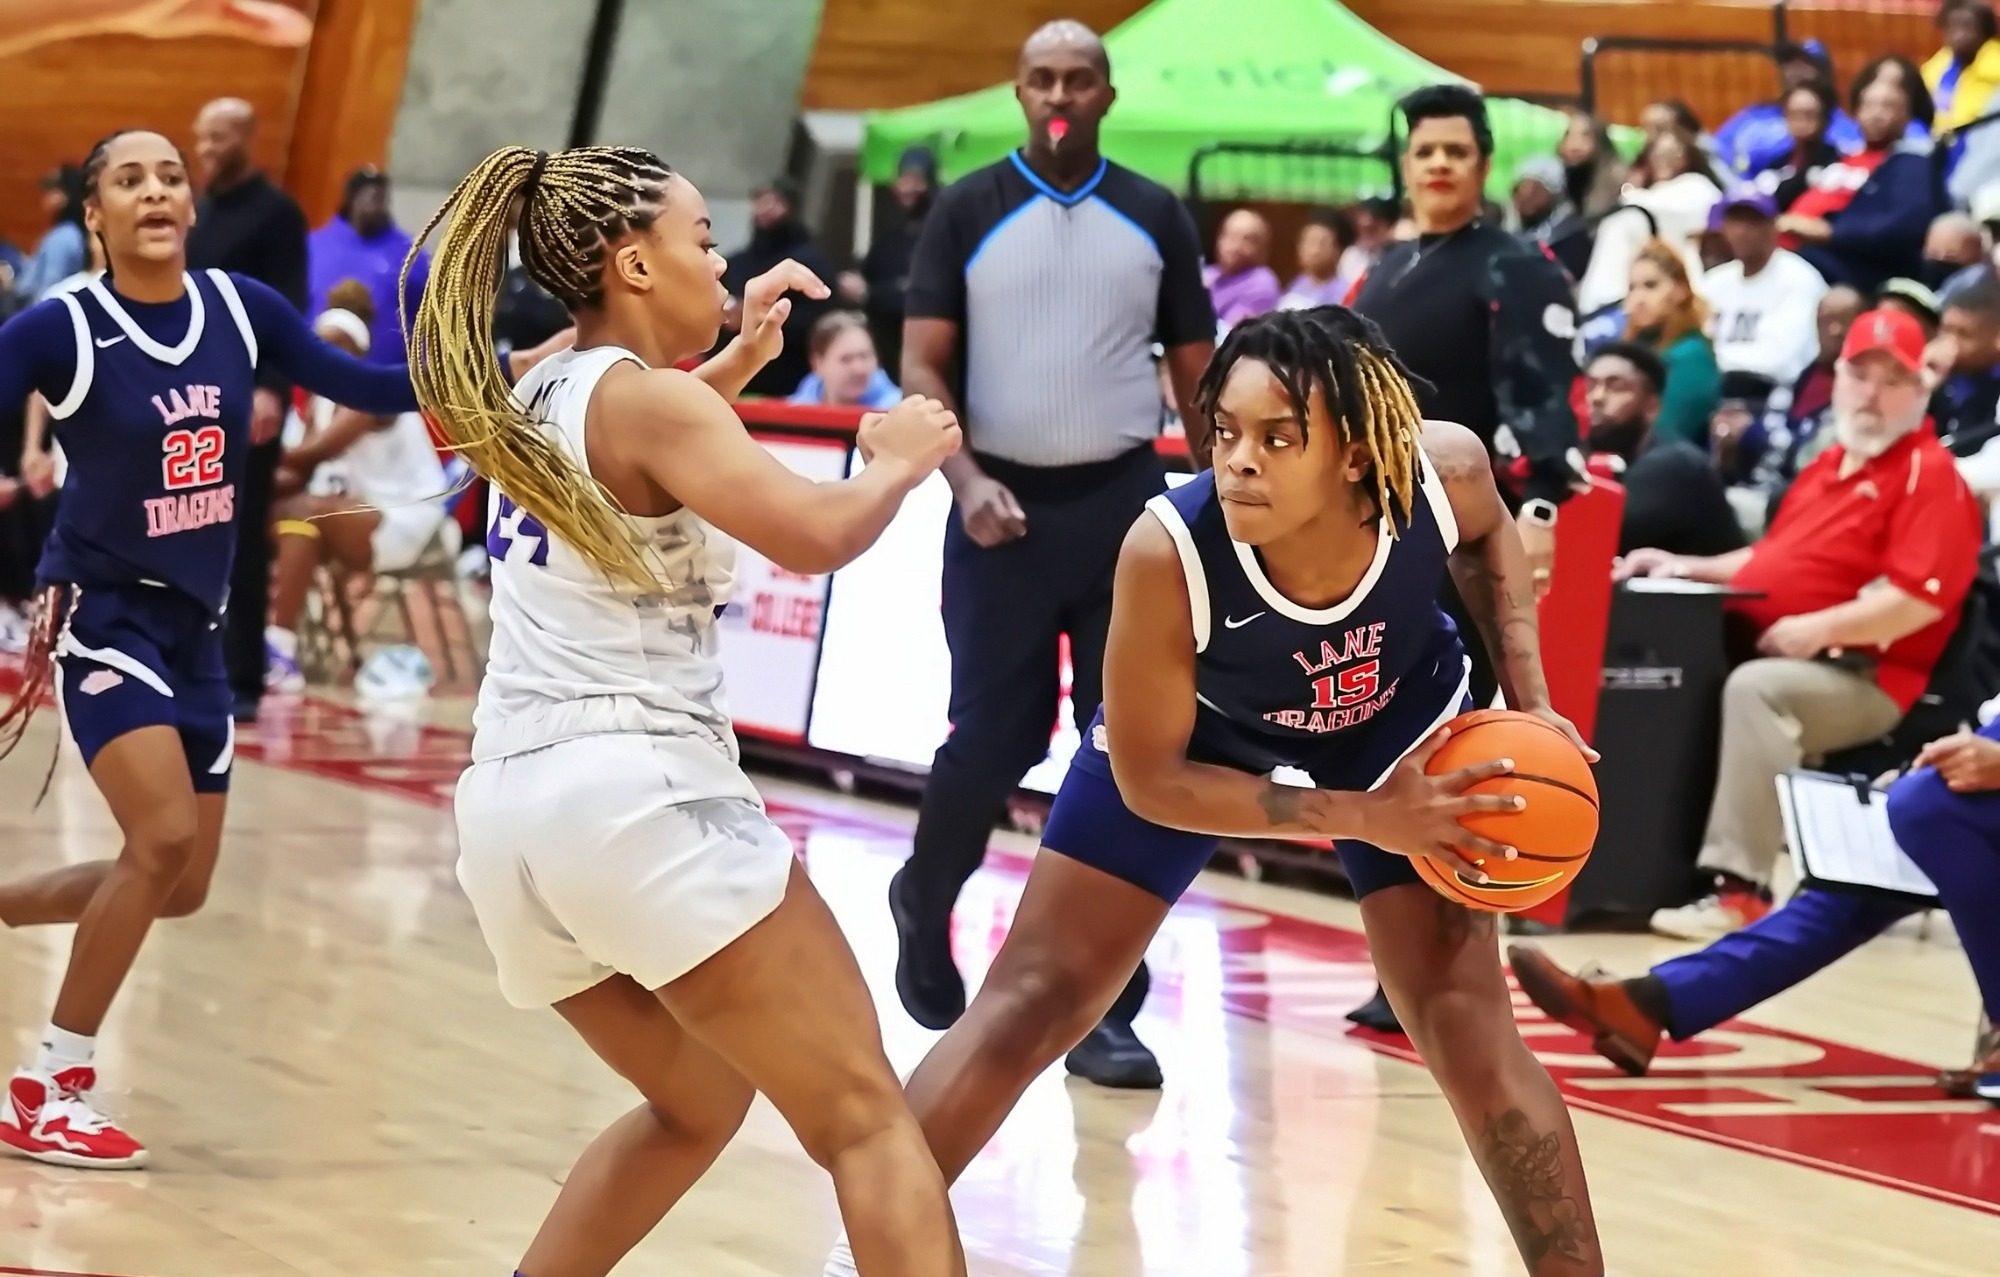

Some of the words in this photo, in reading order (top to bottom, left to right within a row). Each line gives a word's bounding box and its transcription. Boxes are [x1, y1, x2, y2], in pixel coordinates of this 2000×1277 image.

[151, 384, 221, 426] LANE
[162, 425, 226, 491] 22
[143, 484, 235, 538] DRAGONS
[1292, 621, 1386, 676] LANE
[1262, 676, 1400, 734] DRAGONS
[1311, 659, 1380, 709] 15
